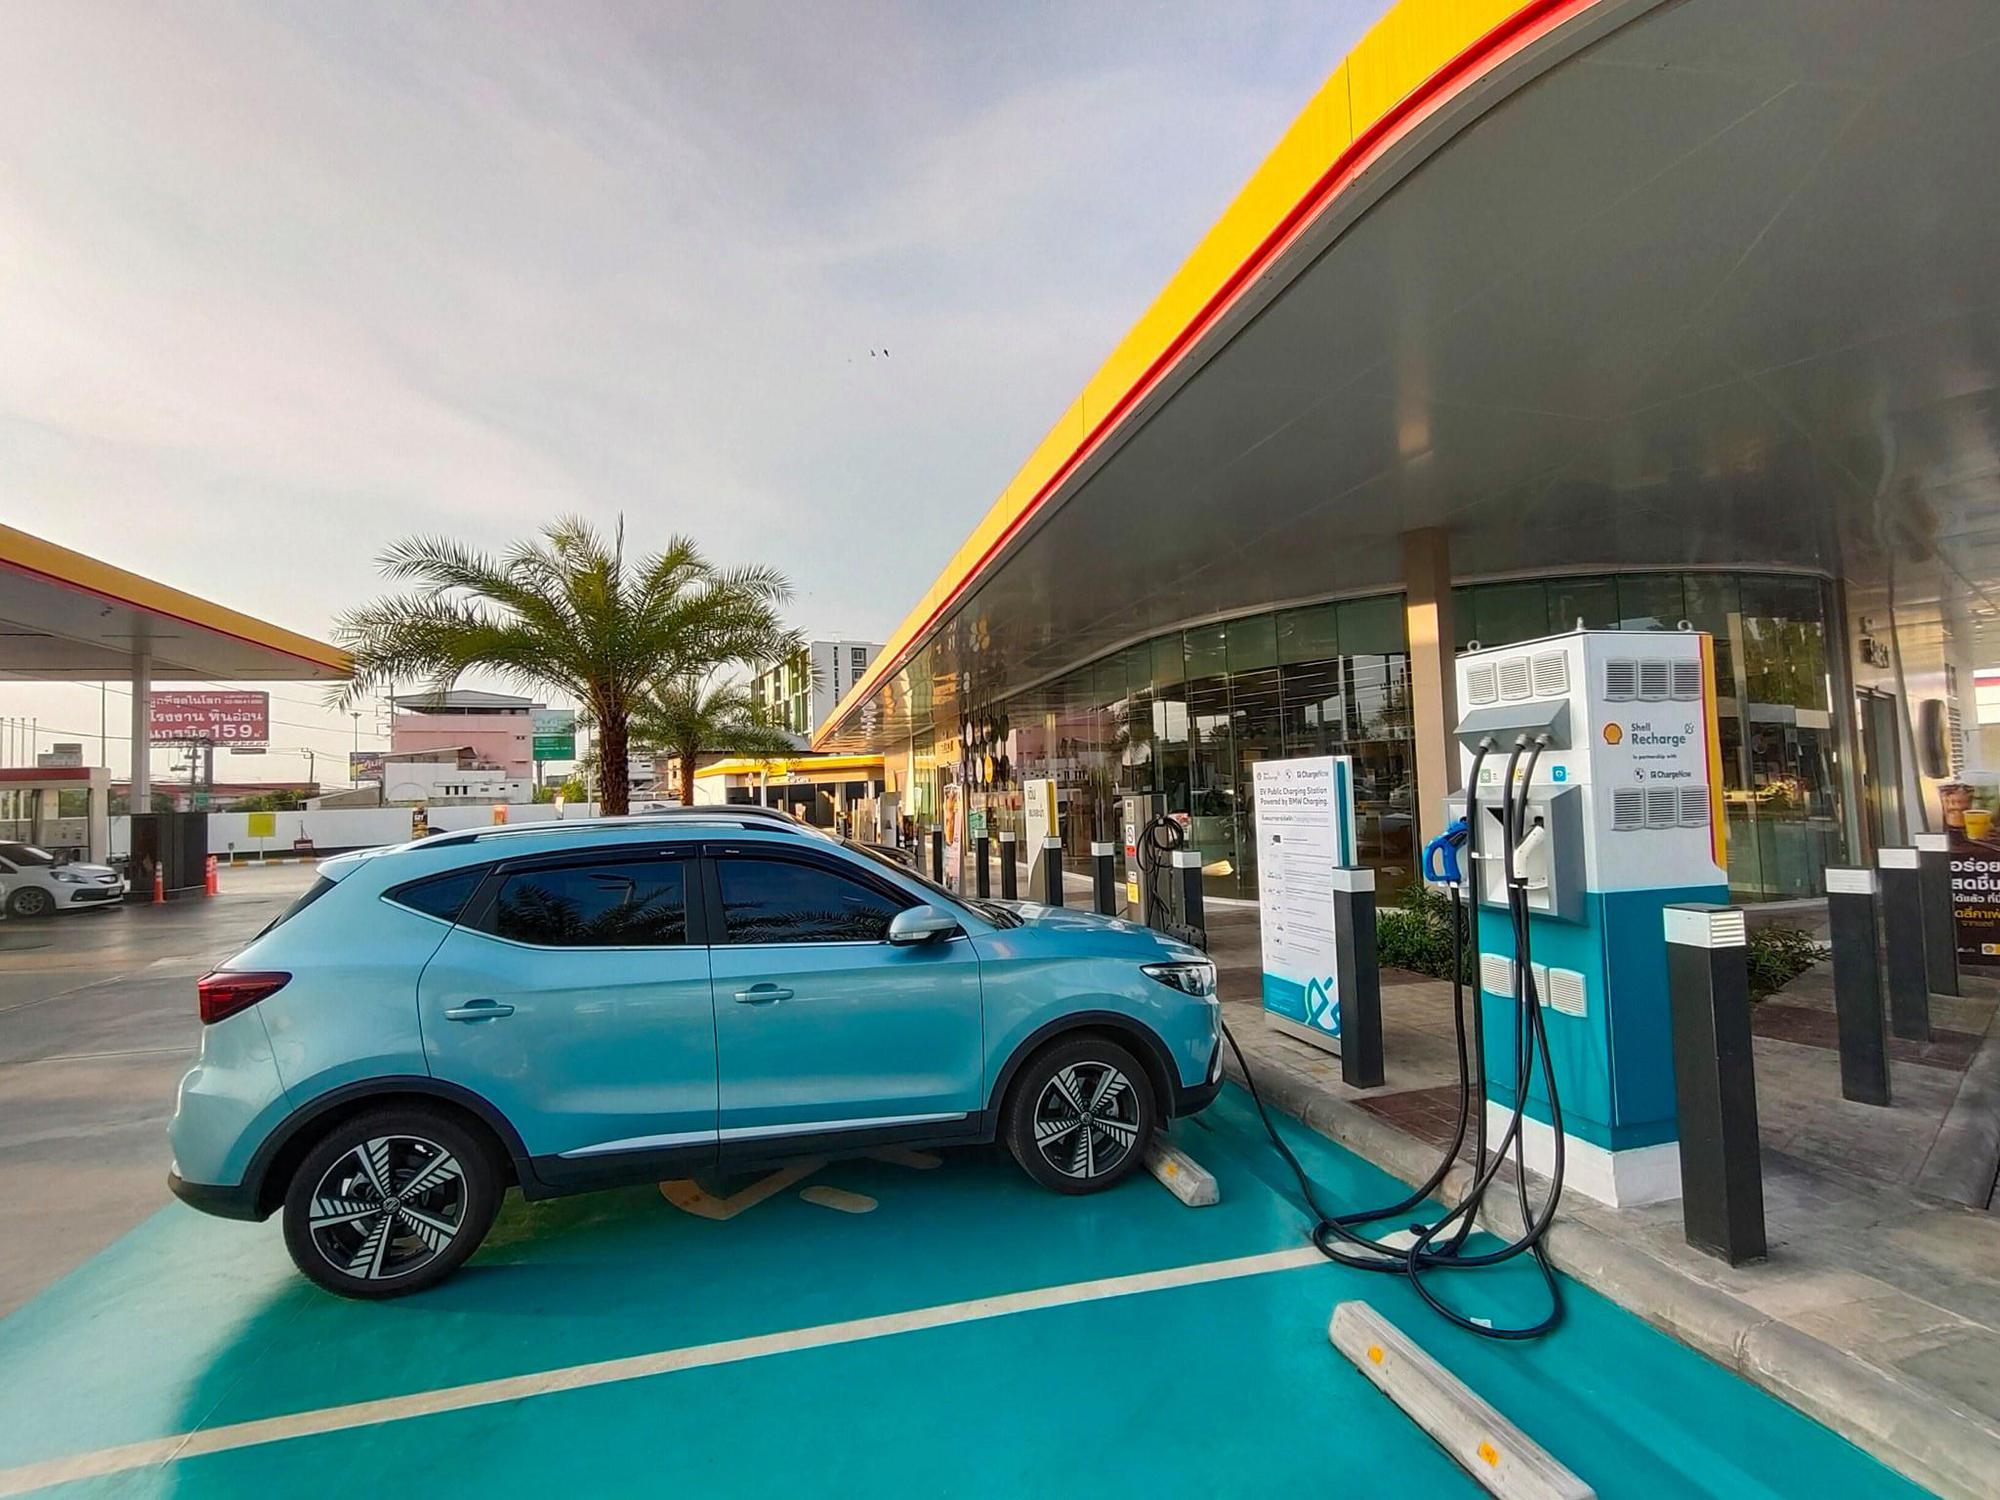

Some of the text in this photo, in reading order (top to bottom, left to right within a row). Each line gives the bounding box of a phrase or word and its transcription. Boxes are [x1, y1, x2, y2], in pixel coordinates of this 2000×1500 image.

[211, 724, 252, 738] 159
[1631, 723, 1651, 732] Shell
[1631, 732, 1687, 748] Recharge
[1267, 787, 1282, 796] Public
[1282, 787, 1306, 797] Charging
[1306, 786, 1327, 795] Station
[1260, 798, 1281, 806] Powered
[1950, 857, 2000, 872] อร่อย
